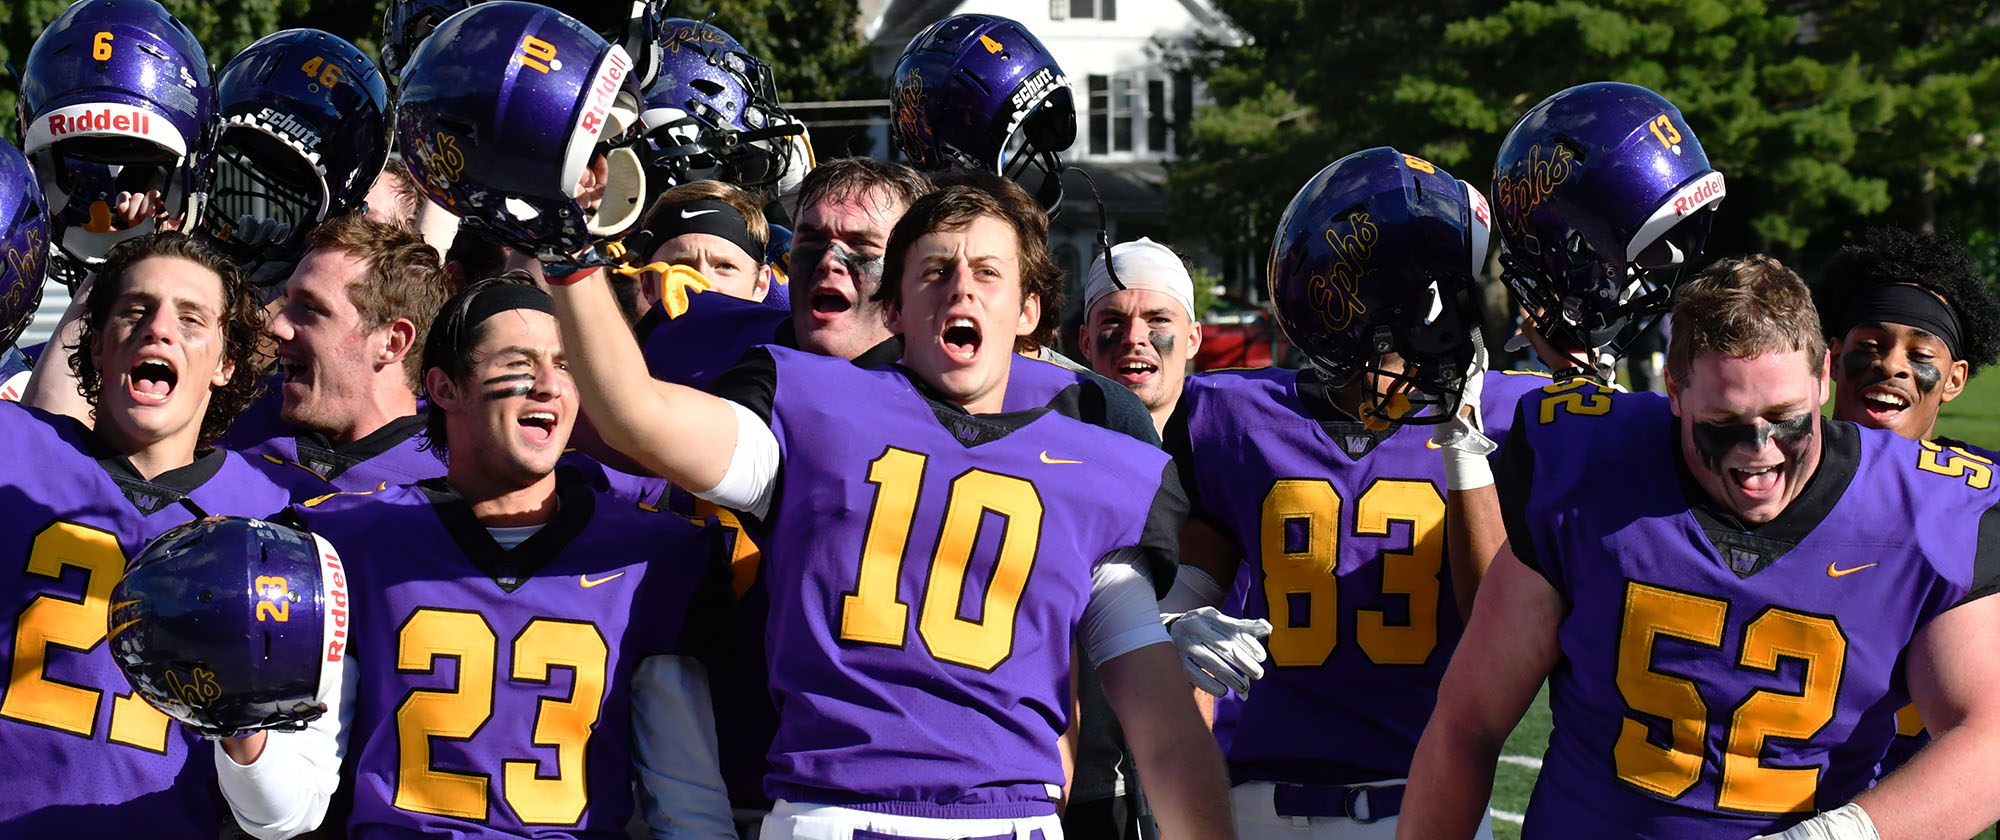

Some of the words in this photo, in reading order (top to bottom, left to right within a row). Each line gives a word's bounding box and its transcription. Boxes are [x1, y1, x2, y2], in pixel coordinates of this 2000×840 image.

[93, 32, 113, 61] 6
[515, 35, 558, 74] 10
[980, 35, 1003, 54] 4
[301, 56, 343, 88] 46
[1011, 69, 1052, 108] schutt
[581, 54, 626, 134] Riddell
[48, 109, 149, 136] Riddell
[259, 107, 321, 148] schutt
[1649, 114, 1682, 149] 13
[1674, 177, 1725, 216] Riddell
[1308, 213, 1378, 330] Ephs
[955, 423, 981, 442] W
[1345, 435, 1371, 454] W
[134, 493, 161, 511] W
[838, 444, 1045, 674] 10
[1259, 477, 1448, 669] 83
[1732, 549, 1759, 572] W
[255, 576, 290, 622] 23
[325, 554, 346, 662] Riddell
[391, 605, 609, 827] 23
[1612, 576, 1848, 817] 52
